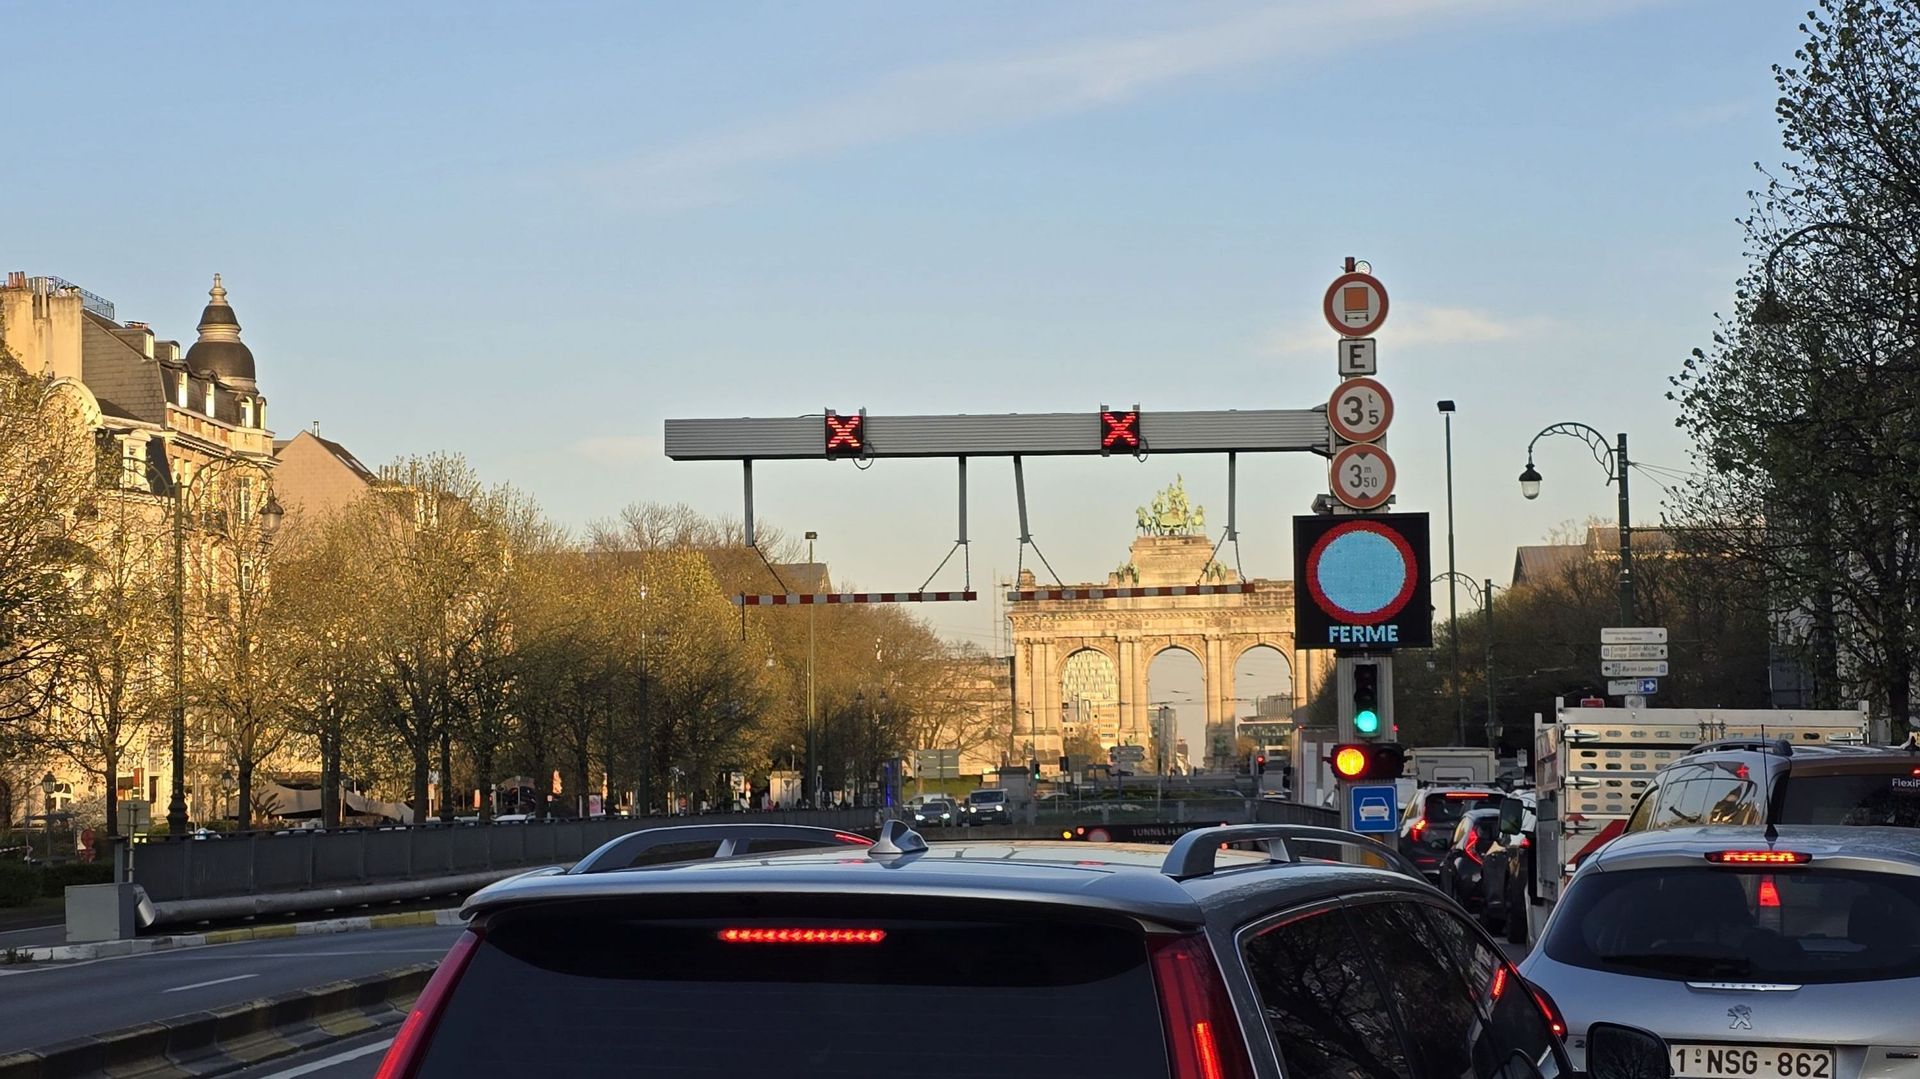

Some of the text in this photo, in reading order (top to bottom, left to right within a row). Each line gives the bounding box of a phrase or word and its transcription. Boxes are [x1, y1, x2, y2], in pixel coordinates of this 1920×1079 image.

[1350, 344, 1366, 369] E
[1328, 624, 1399, 643] FERME
[1132, 827, 1167, 837] TUNNEL
